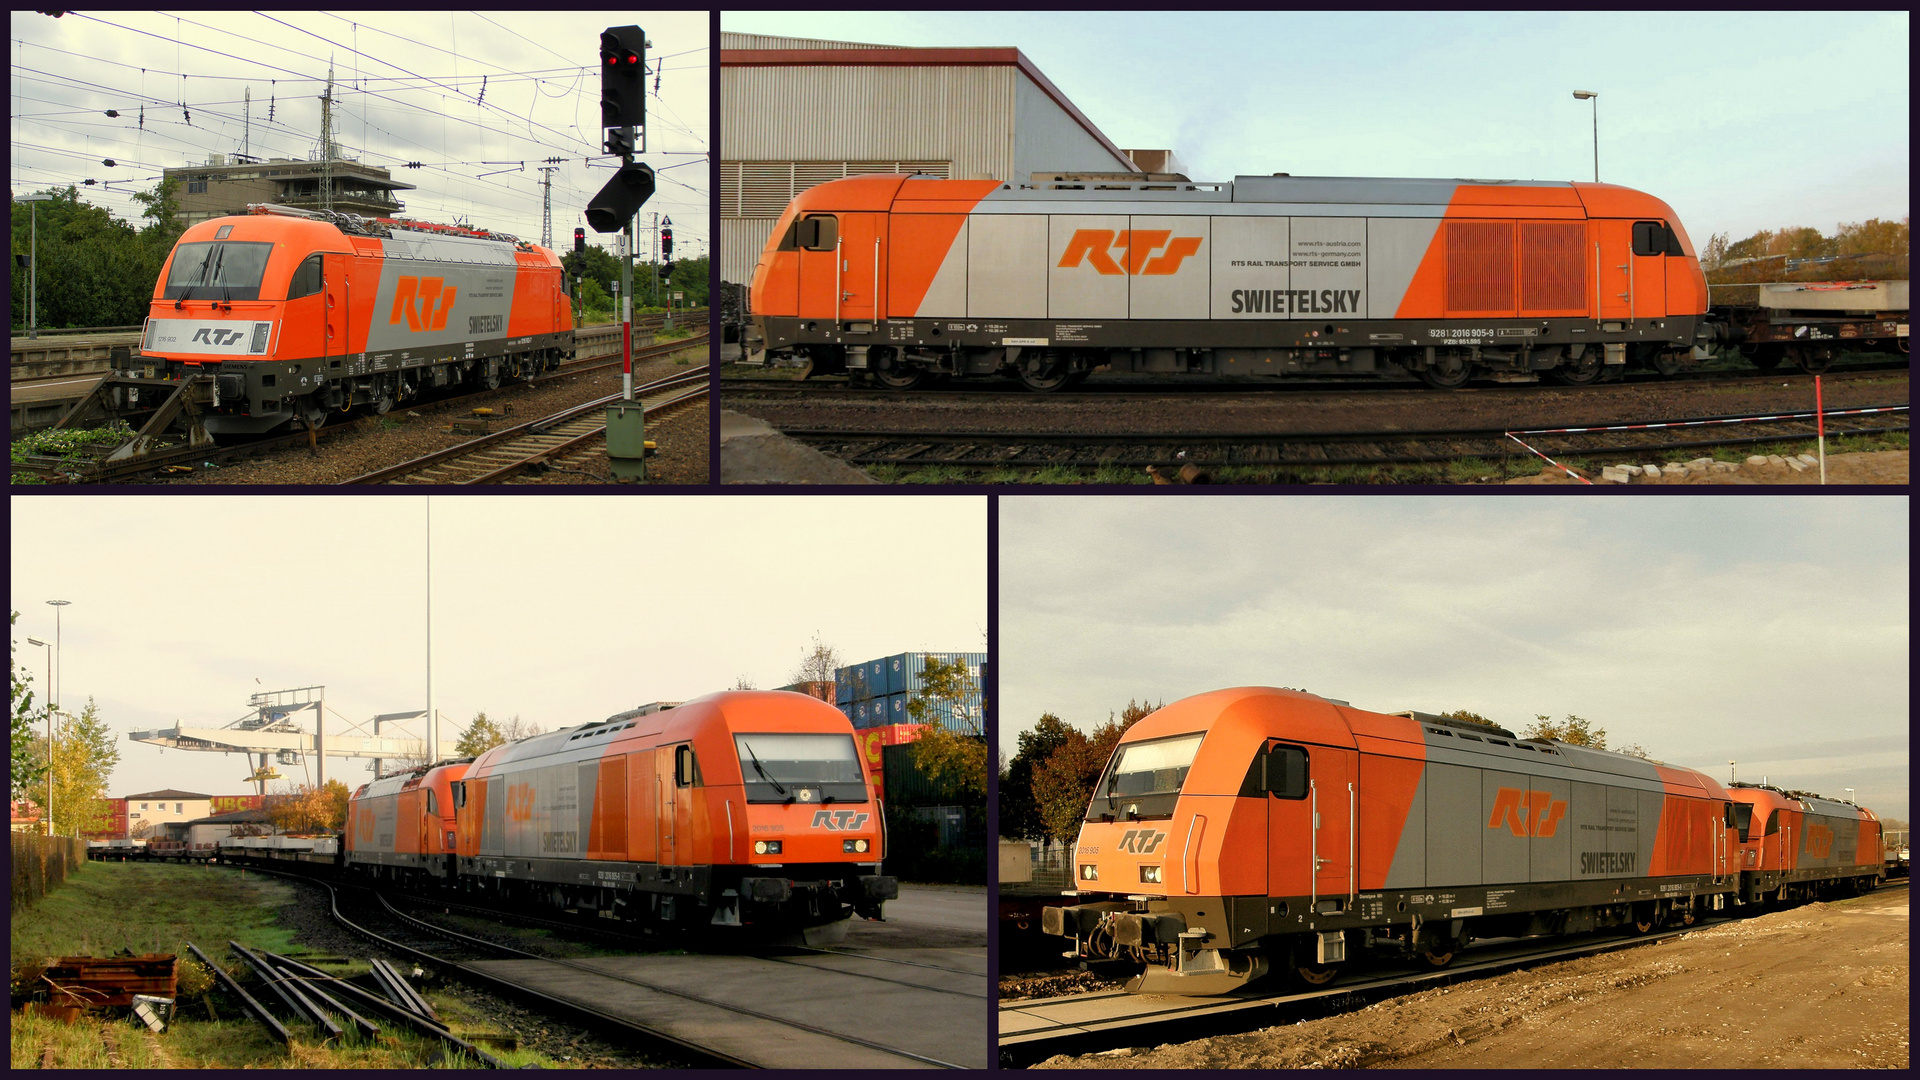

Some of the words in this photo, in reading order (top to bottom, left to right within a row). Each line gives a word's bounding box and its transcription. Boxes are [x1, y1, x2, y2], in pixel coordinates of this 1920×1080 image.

[619, 236, 626, 247] U
[1057, 229, 1203, 275] RTS
[1292, 250, 1361, 258] www.rts-germany.com
[612, 281, 618, 290] H
[389, 275, 458, 333] RTS
[1231, 289, 1361, 314] SWIETELSKY
[469, 315, 504, 335] SWIETELSKY
[1451, 329, 1471, 338] 2016
[1471, 329, 1494, 337] 905-9
[192, 328, 245, 346] RTS
[145, 367, 153, 375] 15
[811, 809, 870, 831] RTS
[1488, 786, 1568, 838] RTS
[1117, 828, 1167, 855] RTS
[1580, 852, 1636, 874] SWIETELSKY
[1297, 914, 1303, 923] 2
